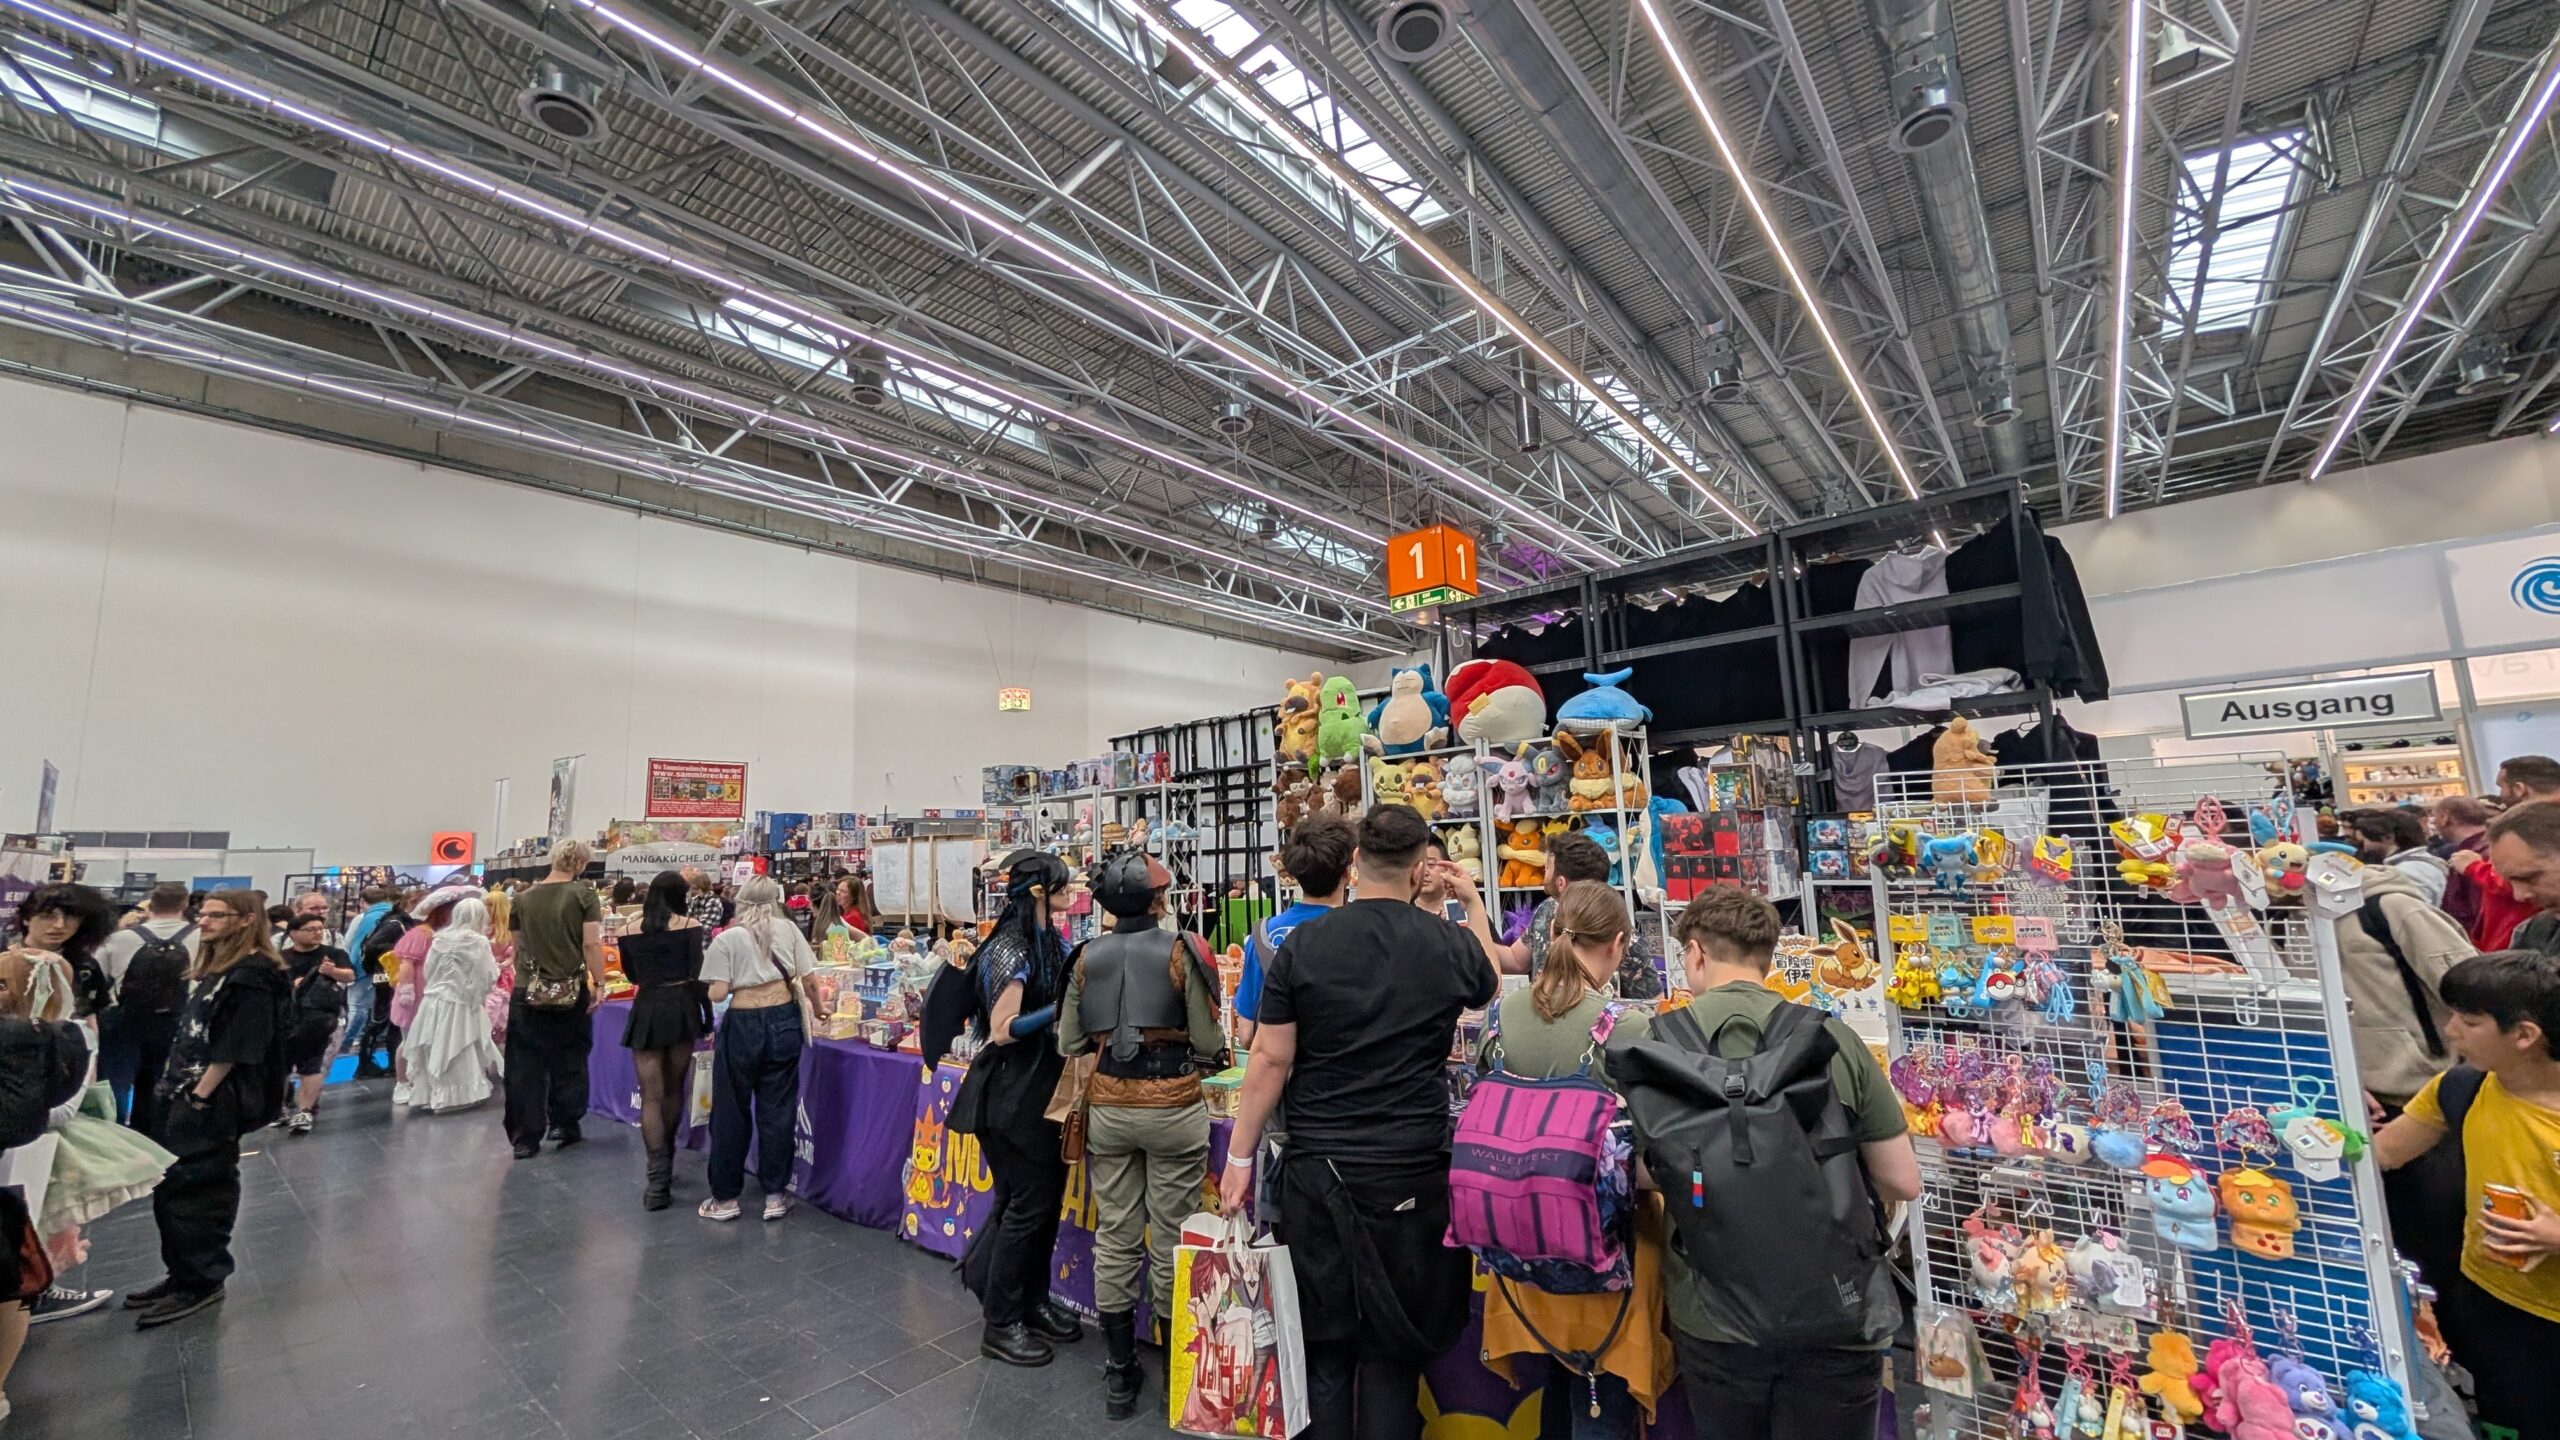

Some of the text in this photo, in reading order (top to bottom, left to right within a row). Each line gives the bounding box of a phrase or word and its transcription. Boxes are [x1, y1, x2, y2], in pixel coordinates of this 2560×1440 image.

[1408, 541, 1424, 580] 1
[1456, 543, 1466, 581] 1
[2220, 693, 2395, 722] Ausgang
[653, 770, 742, 780] www.sammlerecke.de
[621, 852, 716, 864] MANGAKÜCHE.DE
[1672, 865, 1681, 873] R
[1697, 865, 1706, 873] R
[1722, 864, 1731, 873] R
